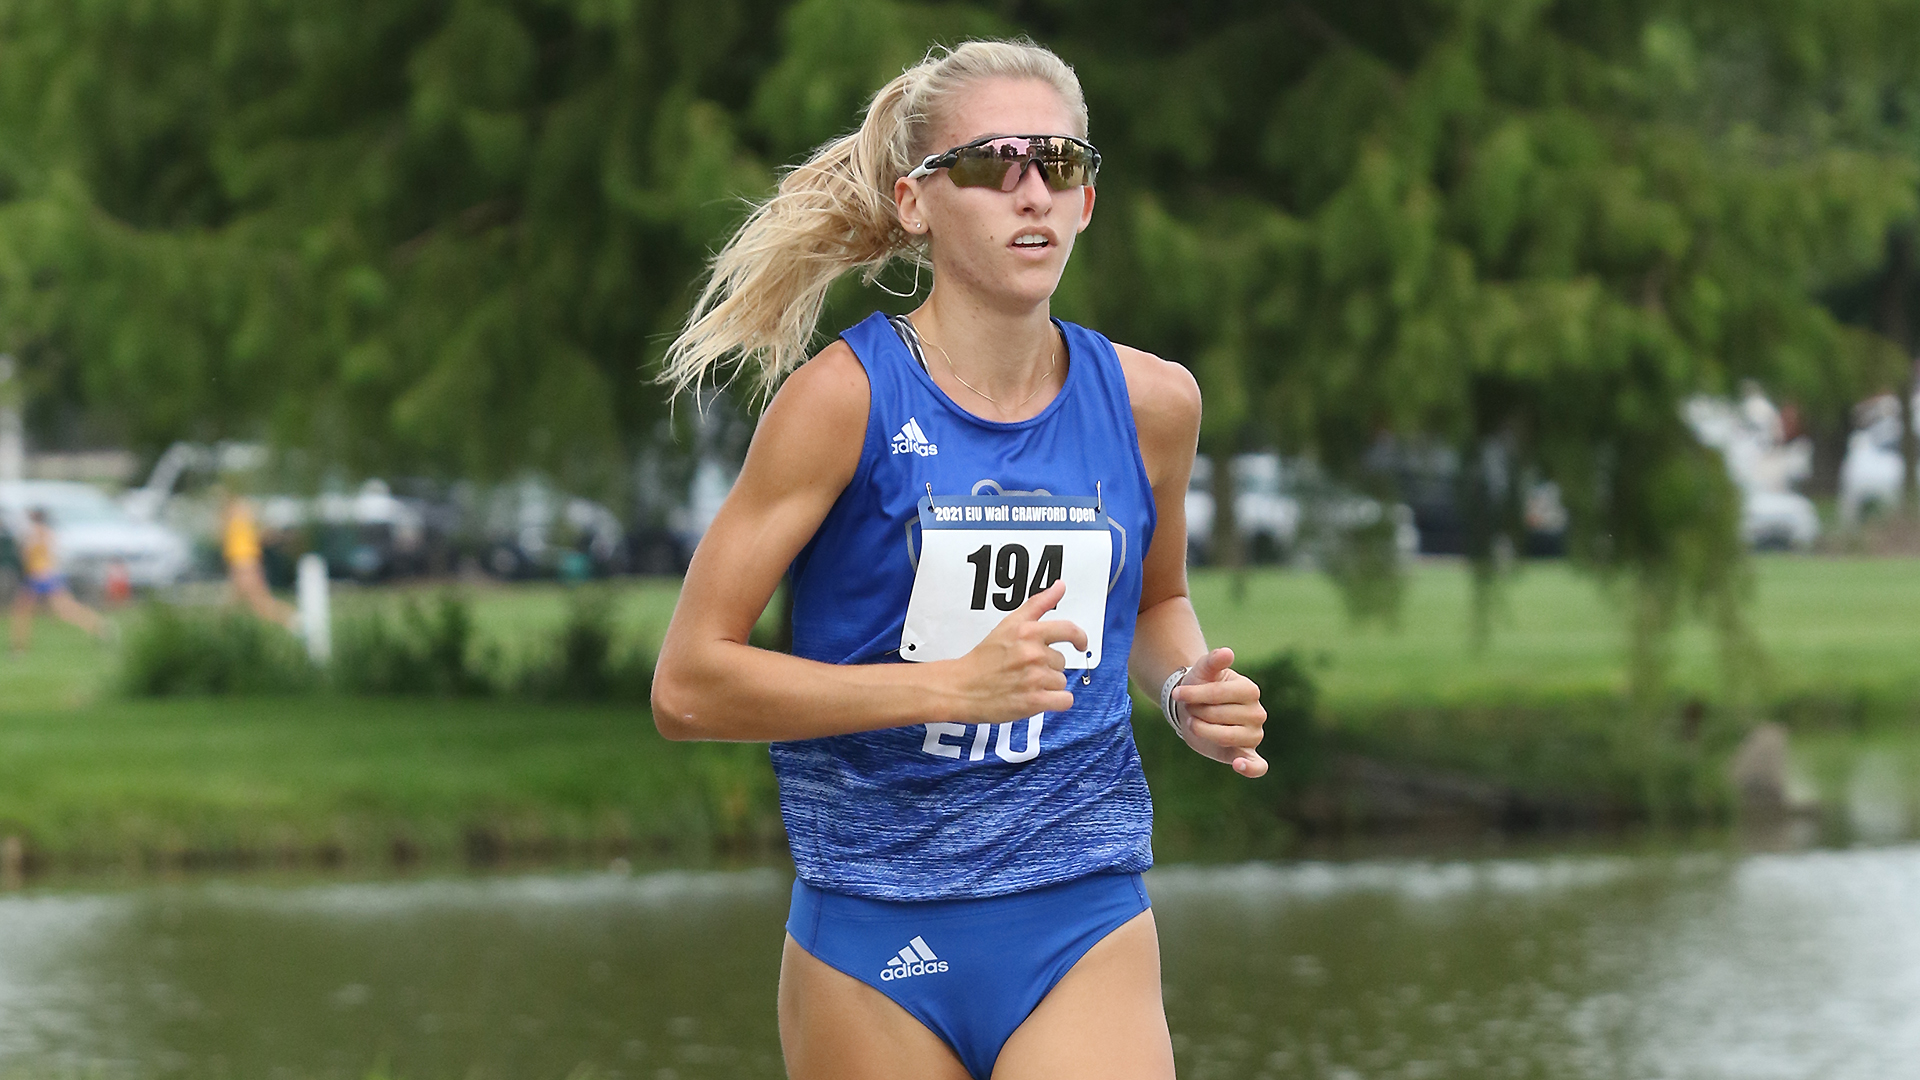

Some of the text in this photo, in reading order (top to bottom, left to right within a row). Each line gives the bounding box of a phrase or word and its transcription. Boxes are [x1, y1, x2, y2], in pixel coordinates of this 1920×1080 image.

[935, 505, 1096, 523] 2021 EIU Walt CRAWFORD Open
[966, 543, 1064, 611] 194
[922, 711, 1045, 764] EIU
[880, 960, 949, 981] adidas
